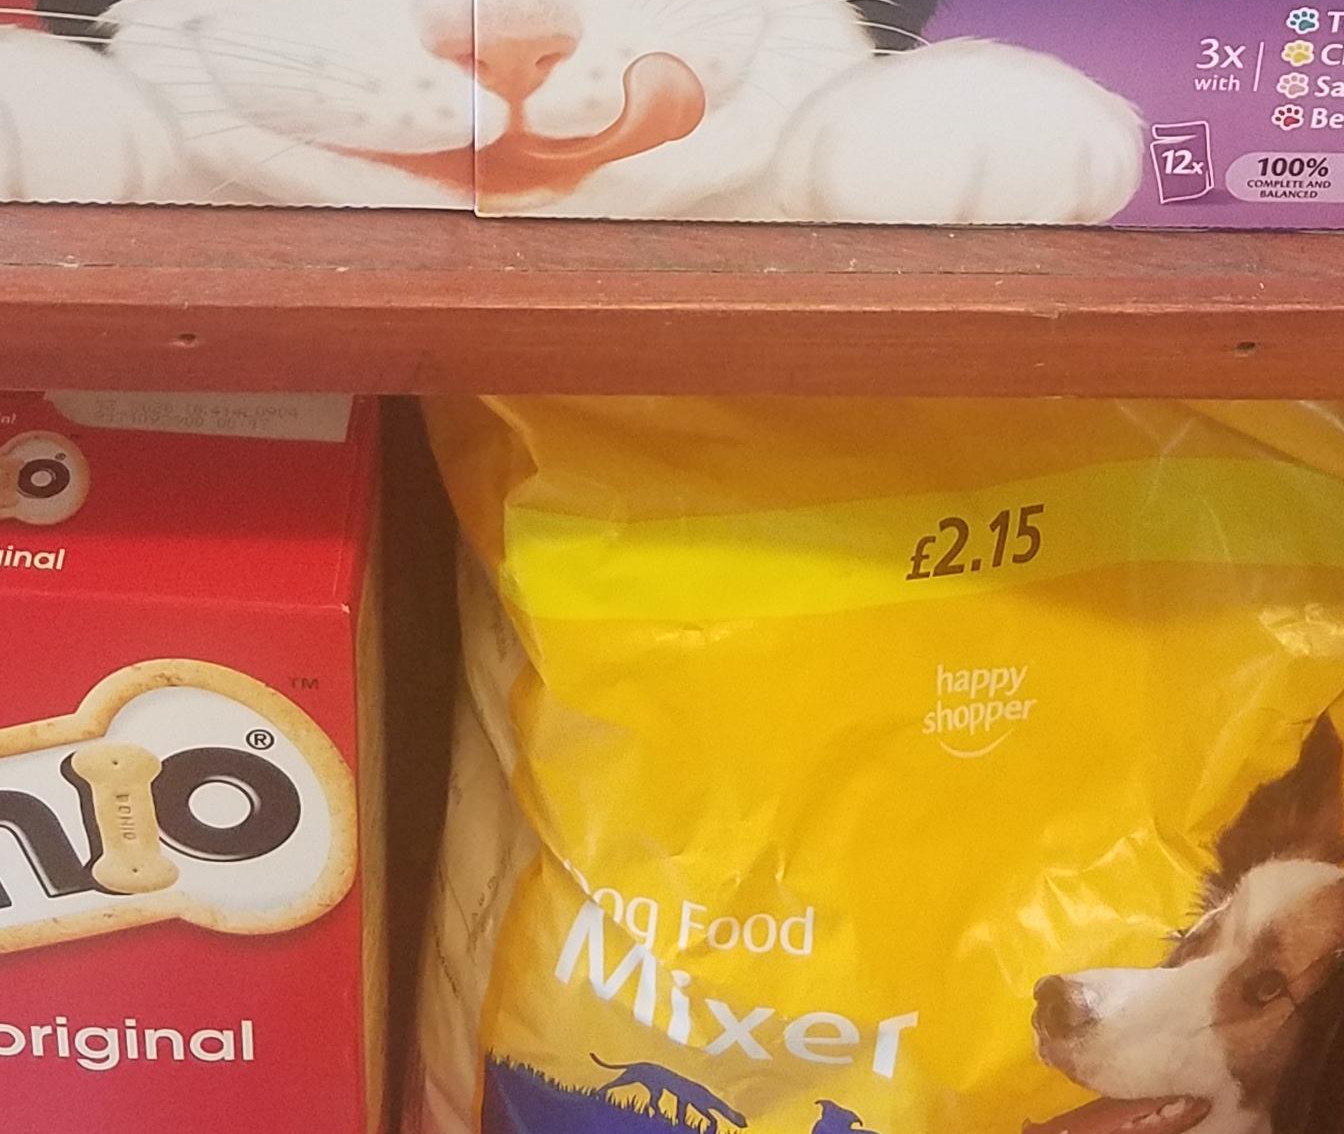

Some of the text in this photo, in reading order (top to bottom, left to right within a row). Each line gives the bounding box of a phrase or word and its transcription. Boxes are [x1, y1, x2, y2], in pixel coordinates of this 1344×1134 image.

[1196, 38, 1246, 69] 3x
[1194, 75, 1240, 92] with
[1161, 150, 1204, 176] 12x
[1256, 157, 1330, 178] 100%
[1246, 179, 1332, 189] COMPLETE AND
[1259, 189, 1318, 199] BALANCED
[905, 505, 1044, 581] £2.15
[935, 665, 1026, 702] happy
[923, 694, 1036, 736] shopper
[563, 858, 815, 955] og Food
[555, 903, 919, 1078] Mixer
